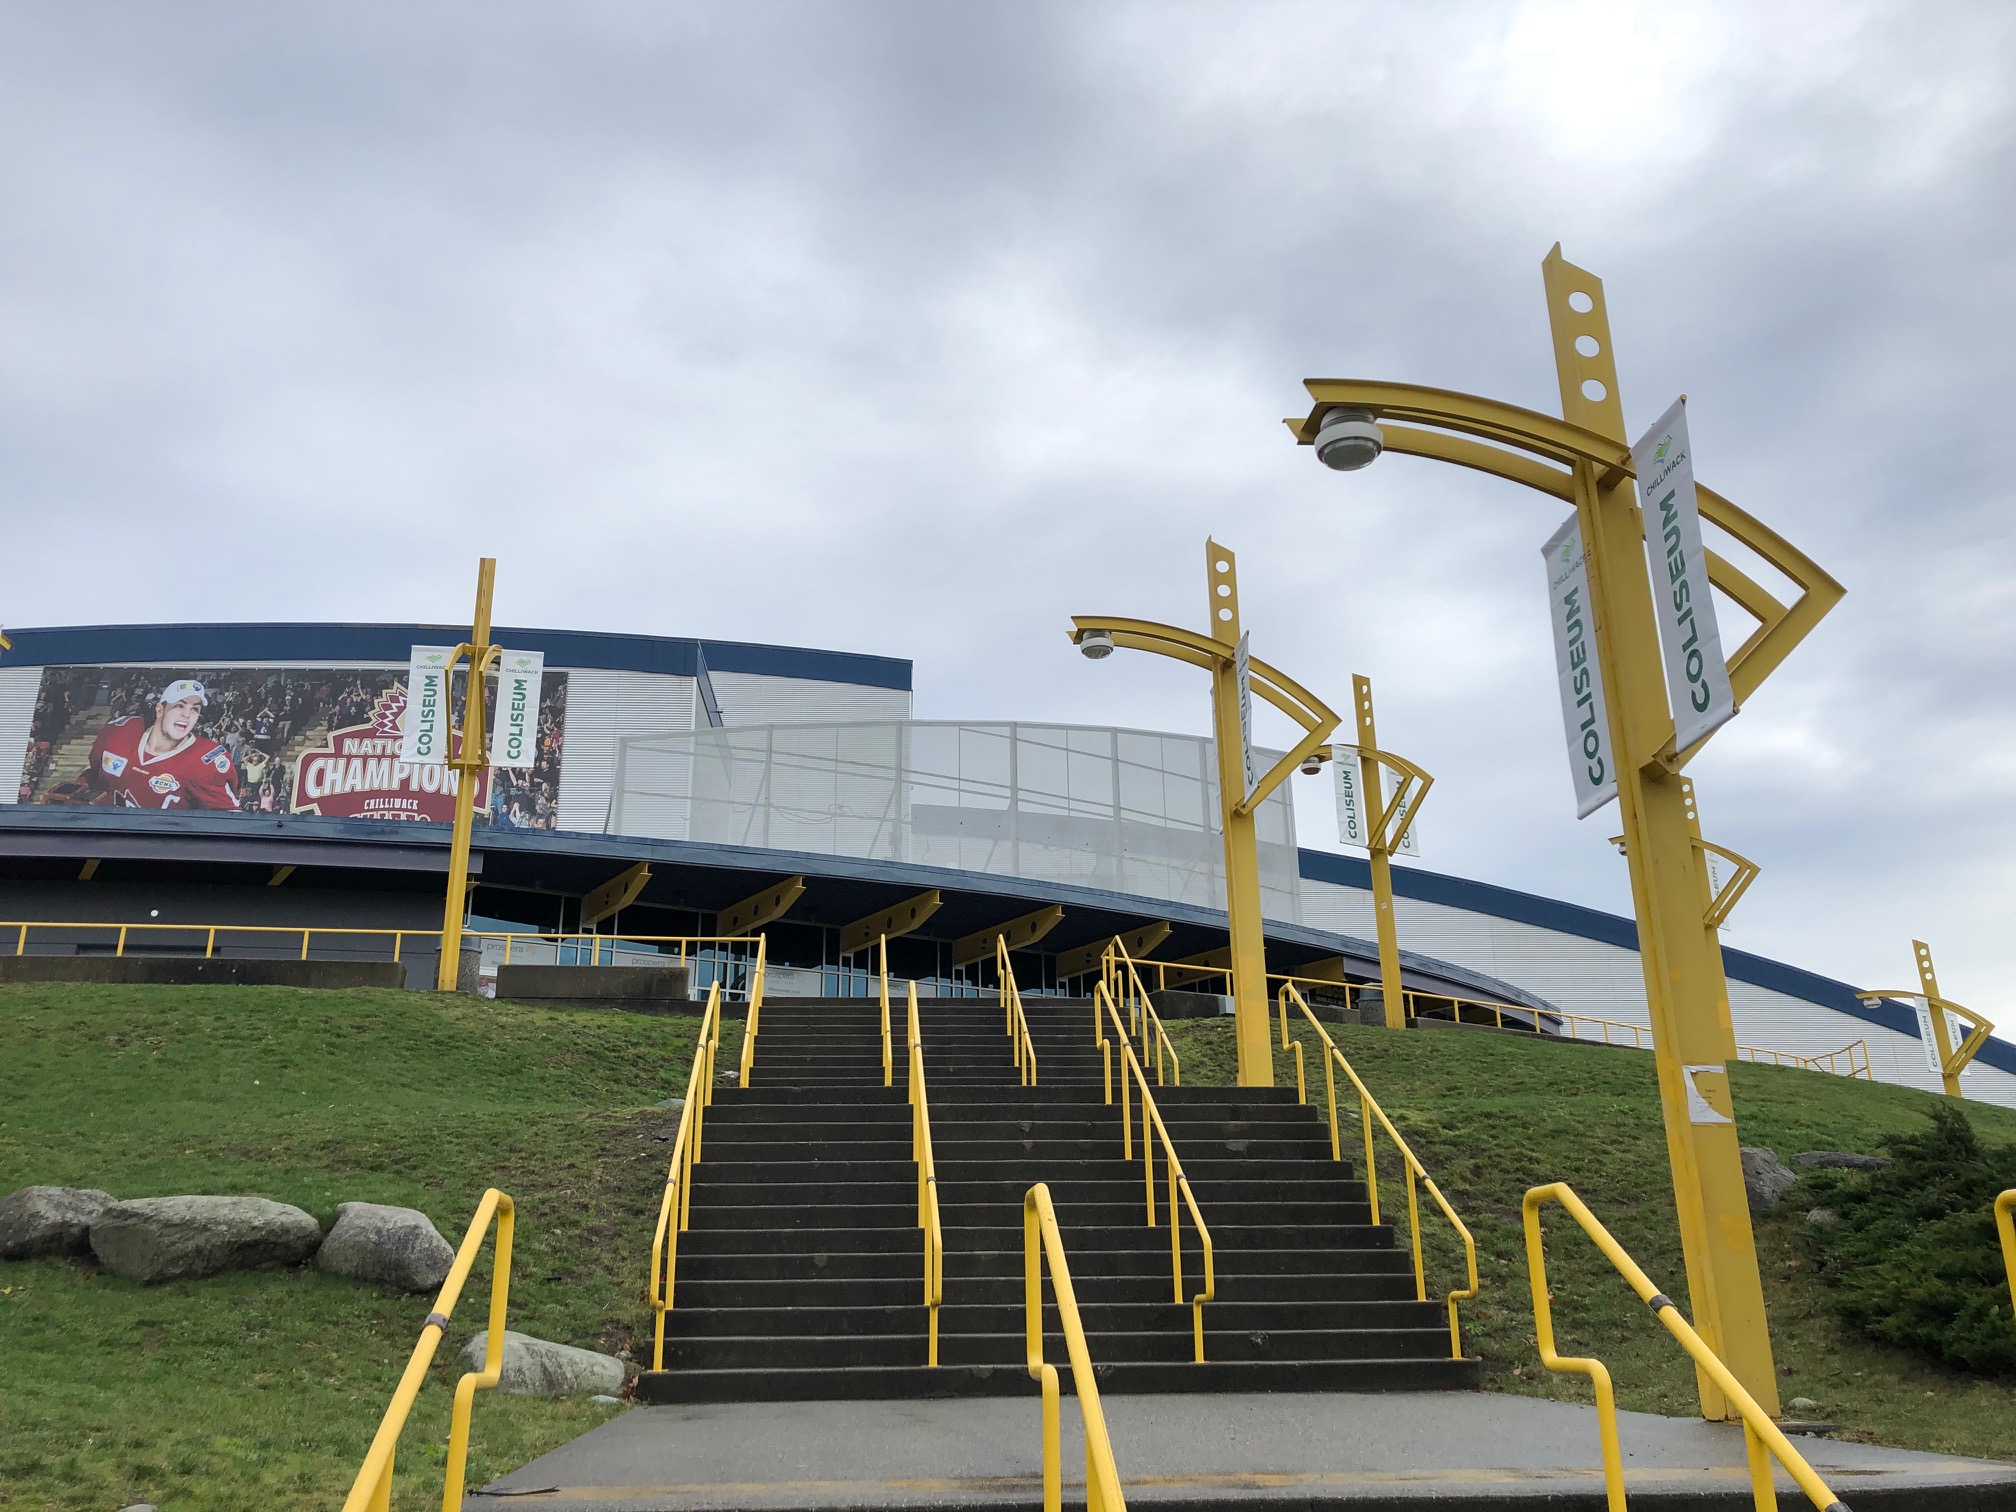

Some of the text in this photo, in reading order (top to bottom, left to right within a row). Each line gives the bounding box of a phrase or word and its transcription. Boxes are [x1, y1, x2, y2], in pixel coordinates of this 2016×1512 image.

[1646, 450, 1687, 497] CHILLIWACK
[1553, 554, 1587, 591] CHILLIWAC
[1659, 488, 1711, 713] COLISEUM
[1563, 586, 1605, 786] COLISEUM
[416, 675, 439, 756] COLISEUM
[506, 678, 528, 760] COLISEUM
[304, 757, 480, 799] CHAMPION
[364, 798, 419, 810] CHILLIWACK
[1342, 770, 1358, 839] COLISEUM
[486, 943, 524, 953] prosera
[1922, 1015, 1938, 1068] COLISEUM
